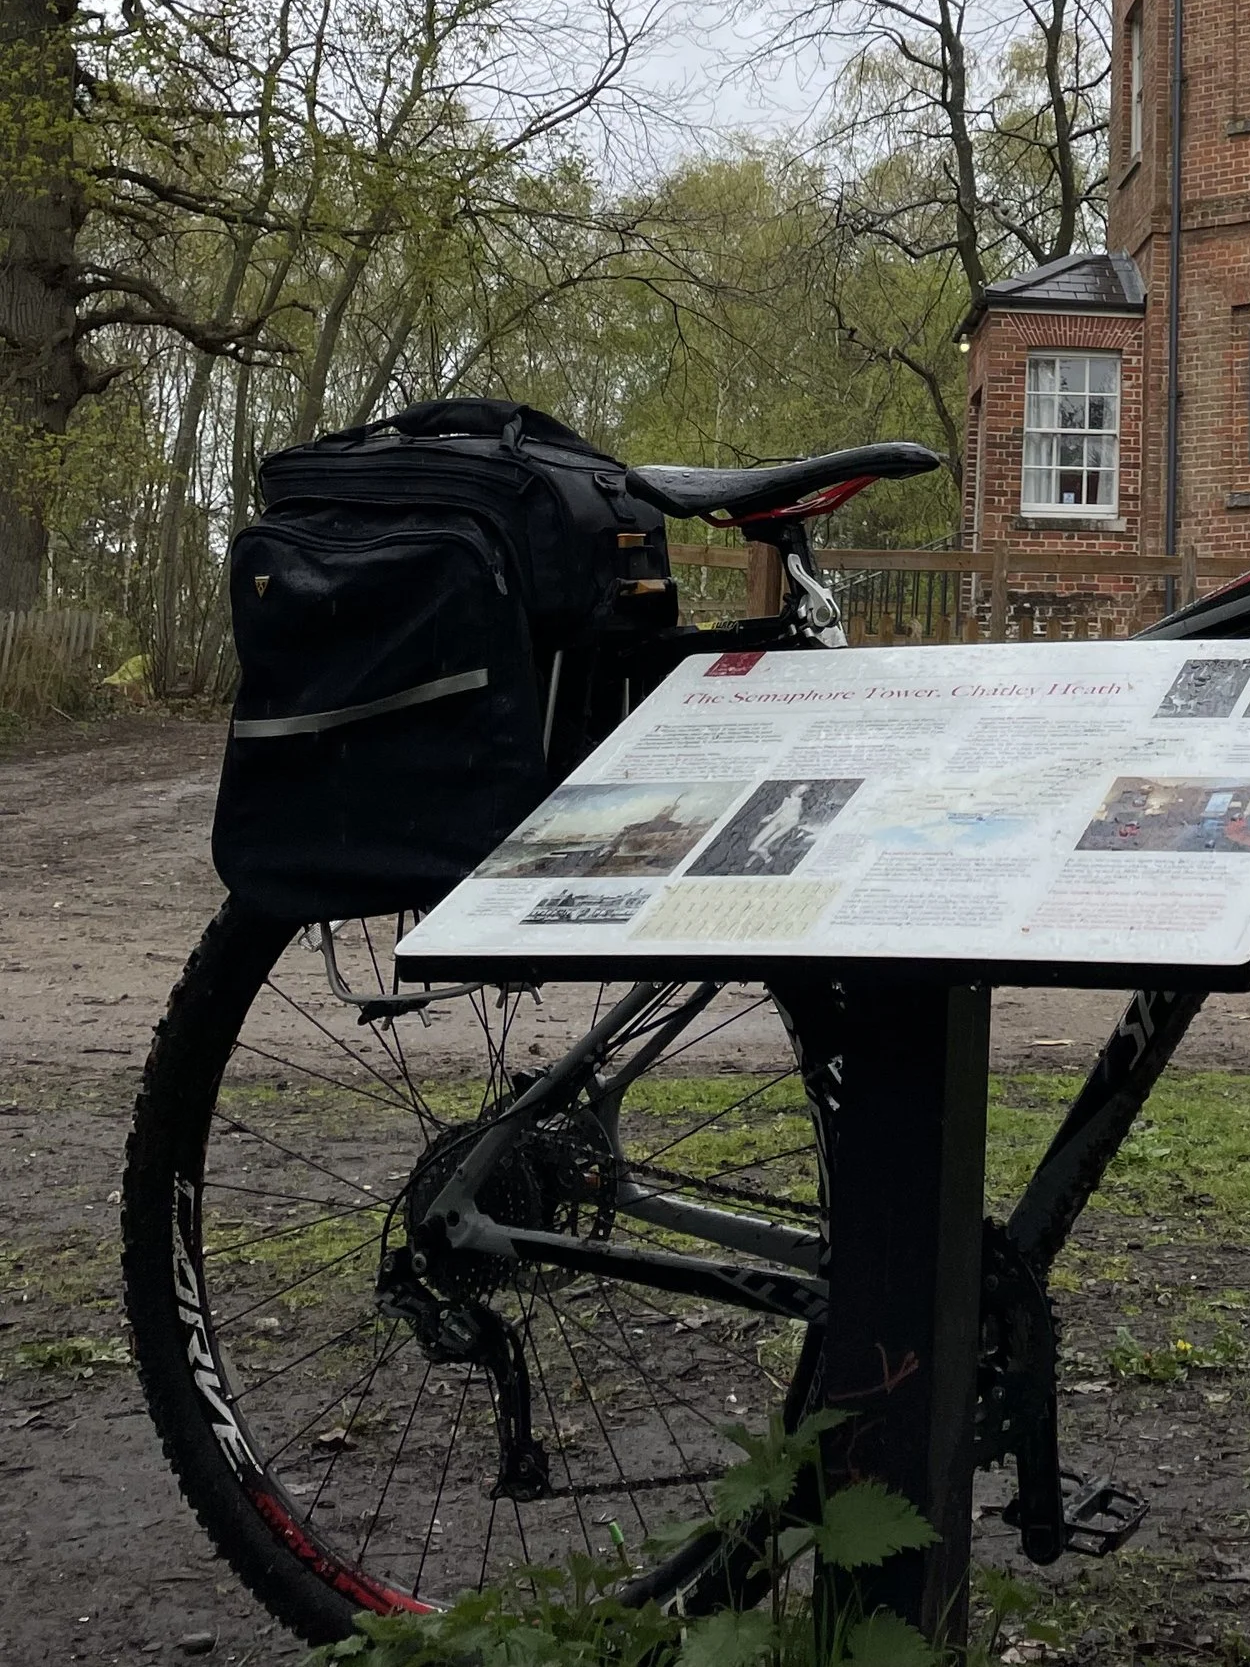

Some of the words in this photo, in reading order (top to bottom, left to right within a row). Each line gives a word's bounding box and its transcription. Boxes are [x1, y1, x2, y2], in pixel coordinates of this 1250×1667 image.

[682, 691, 725, 705] The
[728, 689, 856, 705] Semaphore
[1047, 682, 1122, 696] Heath
